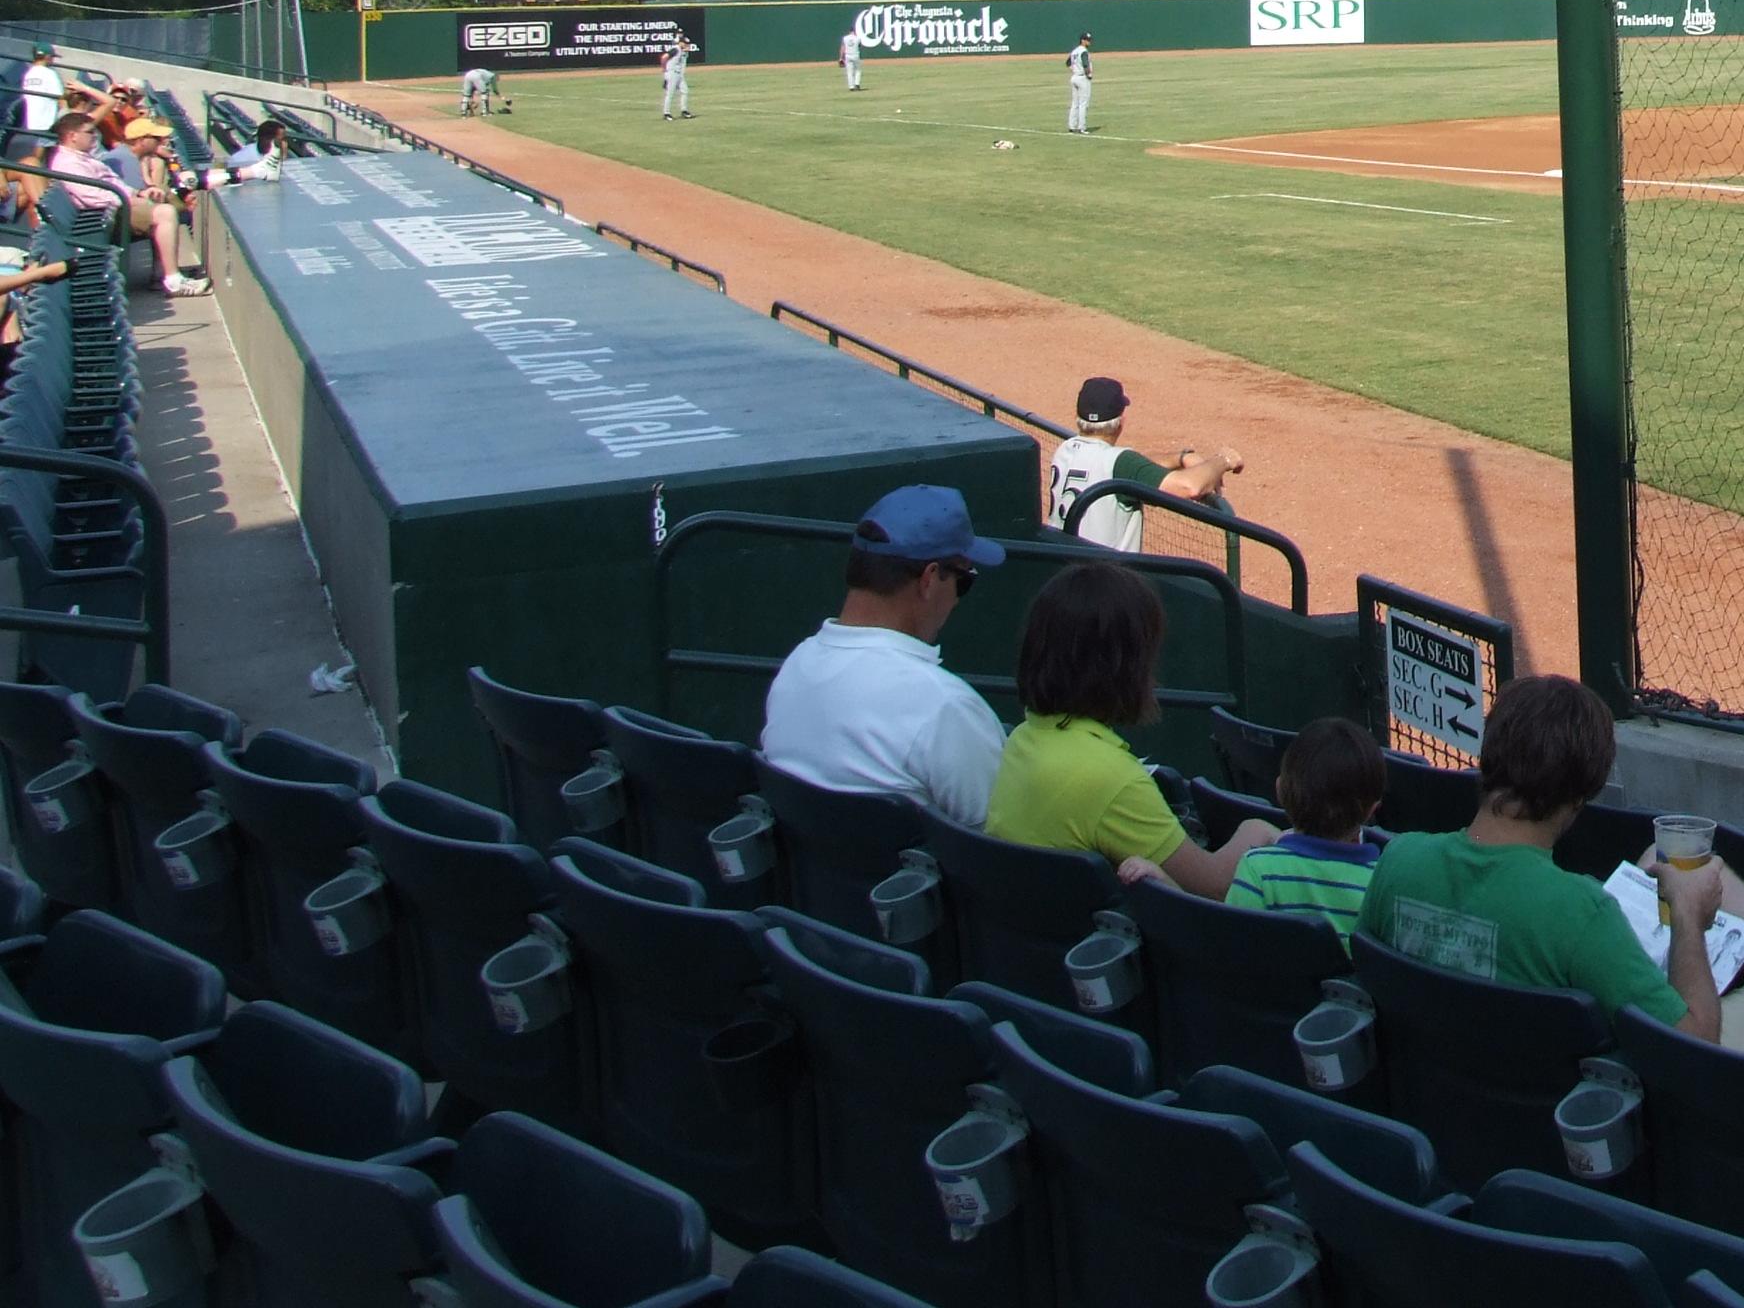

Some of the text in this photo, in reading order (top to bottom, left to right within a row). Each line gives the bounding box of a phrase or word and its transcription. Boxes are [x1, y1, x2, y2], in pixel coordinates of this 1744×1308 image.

[913, 4, 953, 19] Augusta
[1257, 0, 1360, 31] SRP
[470, 27, 546, 46] EZGO
[578, 23, 599, 32] OUR
[600, 22, 642, 31] STARTING
[855, 4, 1009, 52] Chronicle
[574, 35, 593, 44] THE
[594, 34, 624, 43] FINEST
[625, 33, 650, 42] GOLF
[556, 47, 590, 57] UTILITY
[592, 46, 632, 56] VEHICLES
[633, 45, 644, 54] IN
[645, 44, 663, 53] THE
[425, 274, 529, 298] Life
[450, 295, 532, 310] is
[460, 309, 523, 319] a
[507, 346, 615, 384] Live
[545, 382, 650, 401] it
[570, 394, 743, 459] Well.
[1397, 625, 1470, 677] BOX SEATS
[1392, 654, 1443, 699] SEC. G
[1394, 683, 1444, 730] SEC. H
